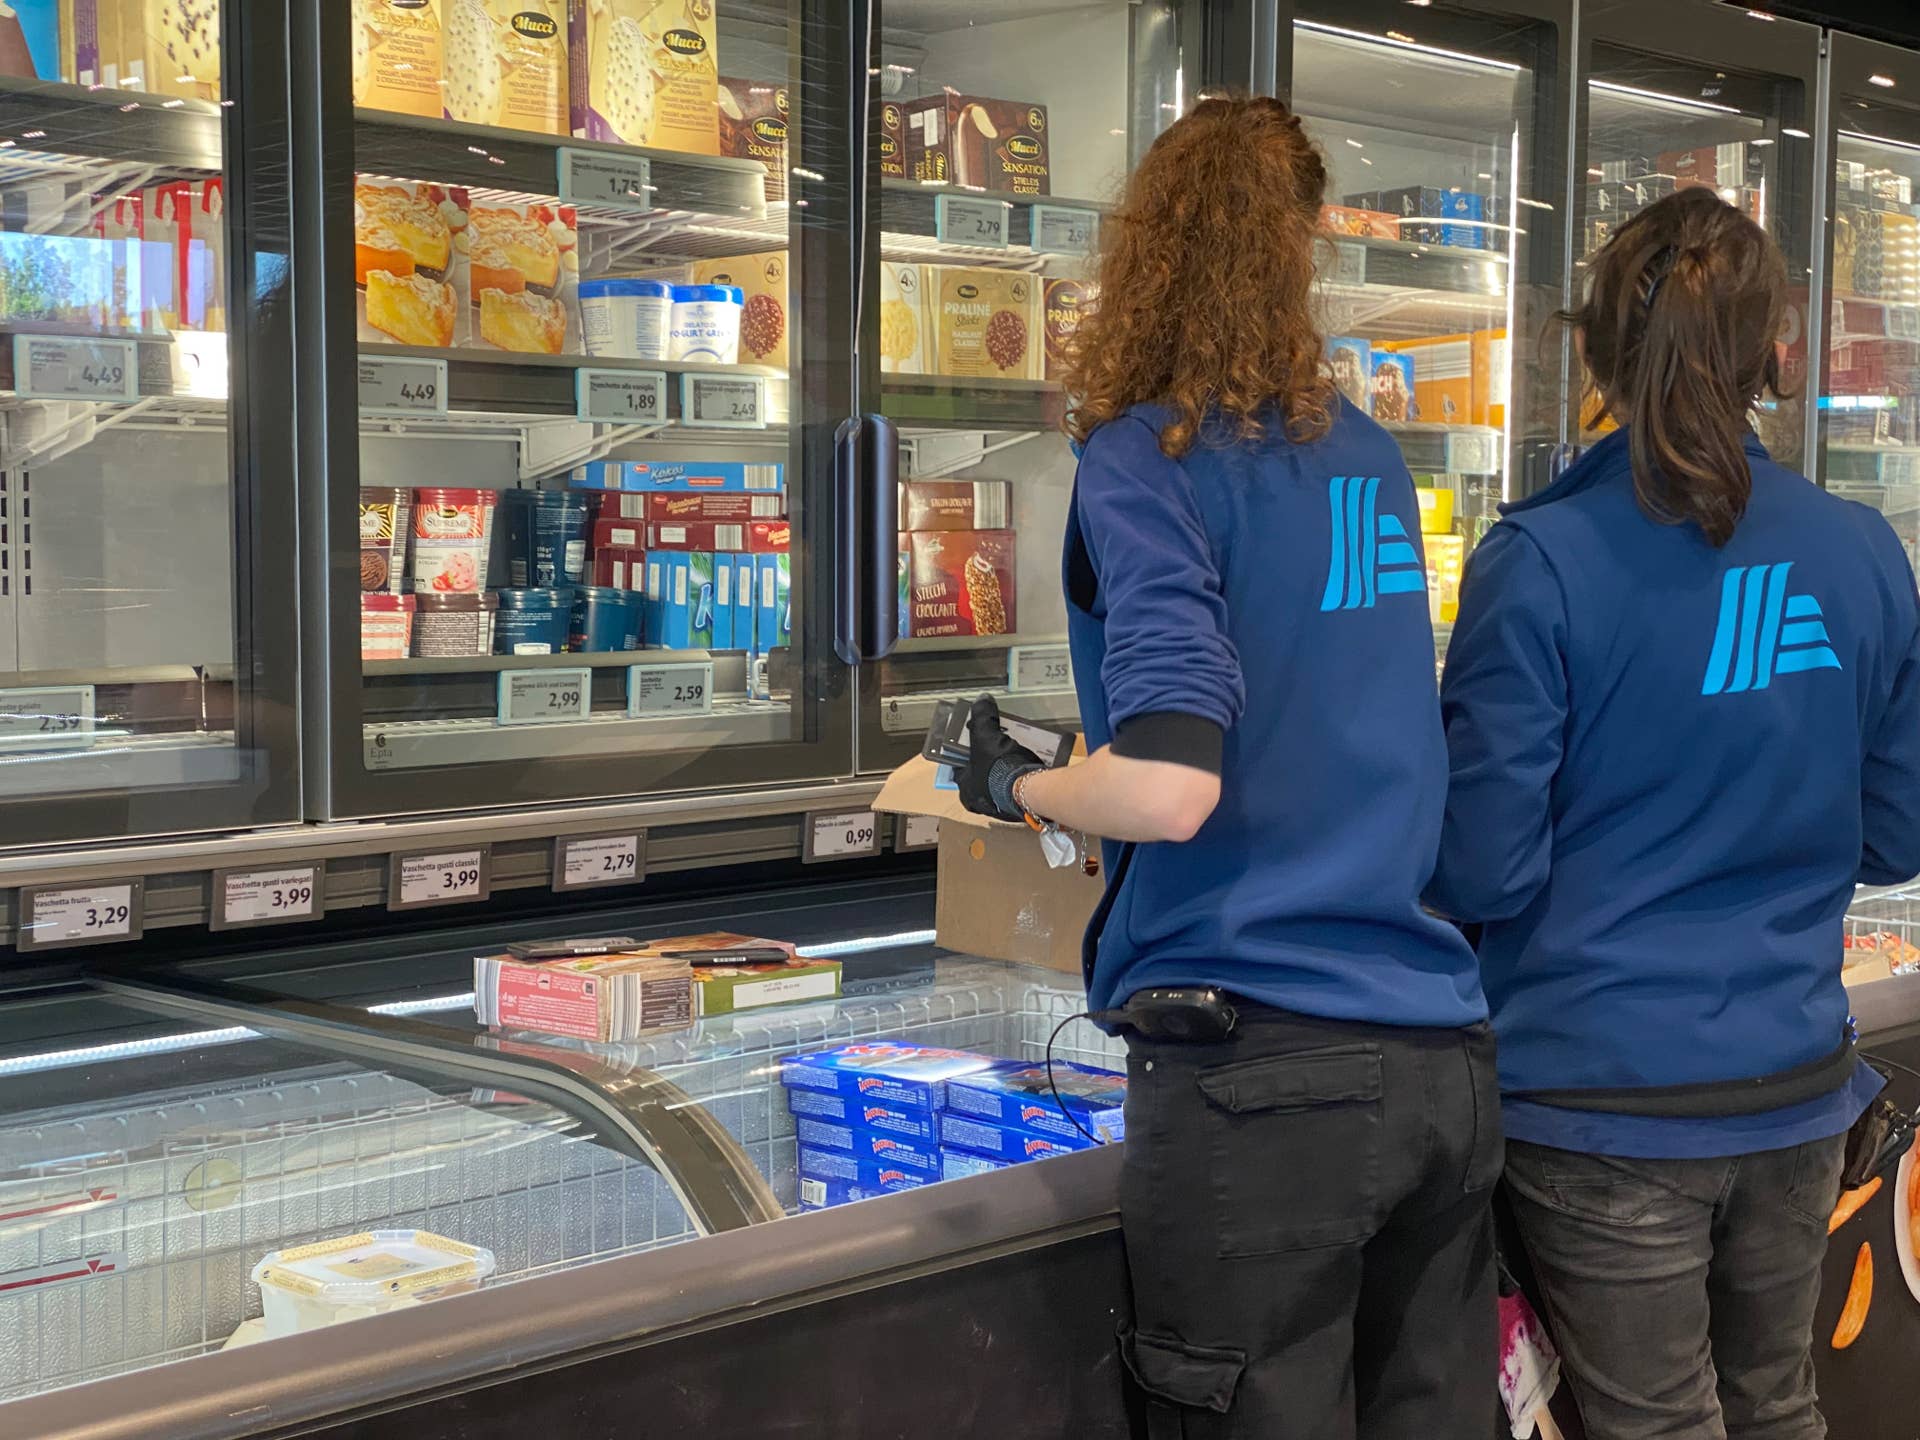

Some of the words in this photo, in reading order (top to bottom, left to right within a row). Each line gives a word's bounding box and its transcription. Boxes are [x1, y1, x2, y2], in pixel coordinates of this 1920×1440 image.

[514, 15, 554, 34] Mucci
[665, 32, 704, 50] Mucci
[1009, 140, 1038, 154] Mucci
[1002, 162, 1048, 176] SENSATION
[608, 178, 639, 196] 1,75
[976, 219, 1000, 234] 2,79
[766, 263, 781, 276] 4x
[900, 273, 914, 287] 4x
[1012, 283, 1026, 297] 4x
[82, 365, 123, 386] 4,49
[401, 383, 436, 402] 4,49
[626, 394, 656, 412] 1,89
[731, 403, 755, 416] 2,49
[651, 464, 685, 480] Kokos
[916, 602, 958, 619] CROCCANTE
[1045, 664, 1069, 679] 2,55
[548, 691, 579, 708] 2,99
[674, 685, 703, 703] 2,59
[370, 748, 392, 760] Epta
[846, 828, 873, 846] 0,99
[402, 864, 436, 873] Vaschetta
[437, 860, 454, 871] gusti
[455, 858, 478, 867] classici
[603, 853, 635, 872] 2,79
[226, 880, 261, 890] Vaschetta
[262, 878, 280, 888] gusti
[280, 875, 312, 885] variegati
[443, 869, 478, 890] 3,99
[34, 898, 70, 908] Vaschetta
[272, 887, 311, 909] 3,99
[85, 905, 128, 928] 3,29
